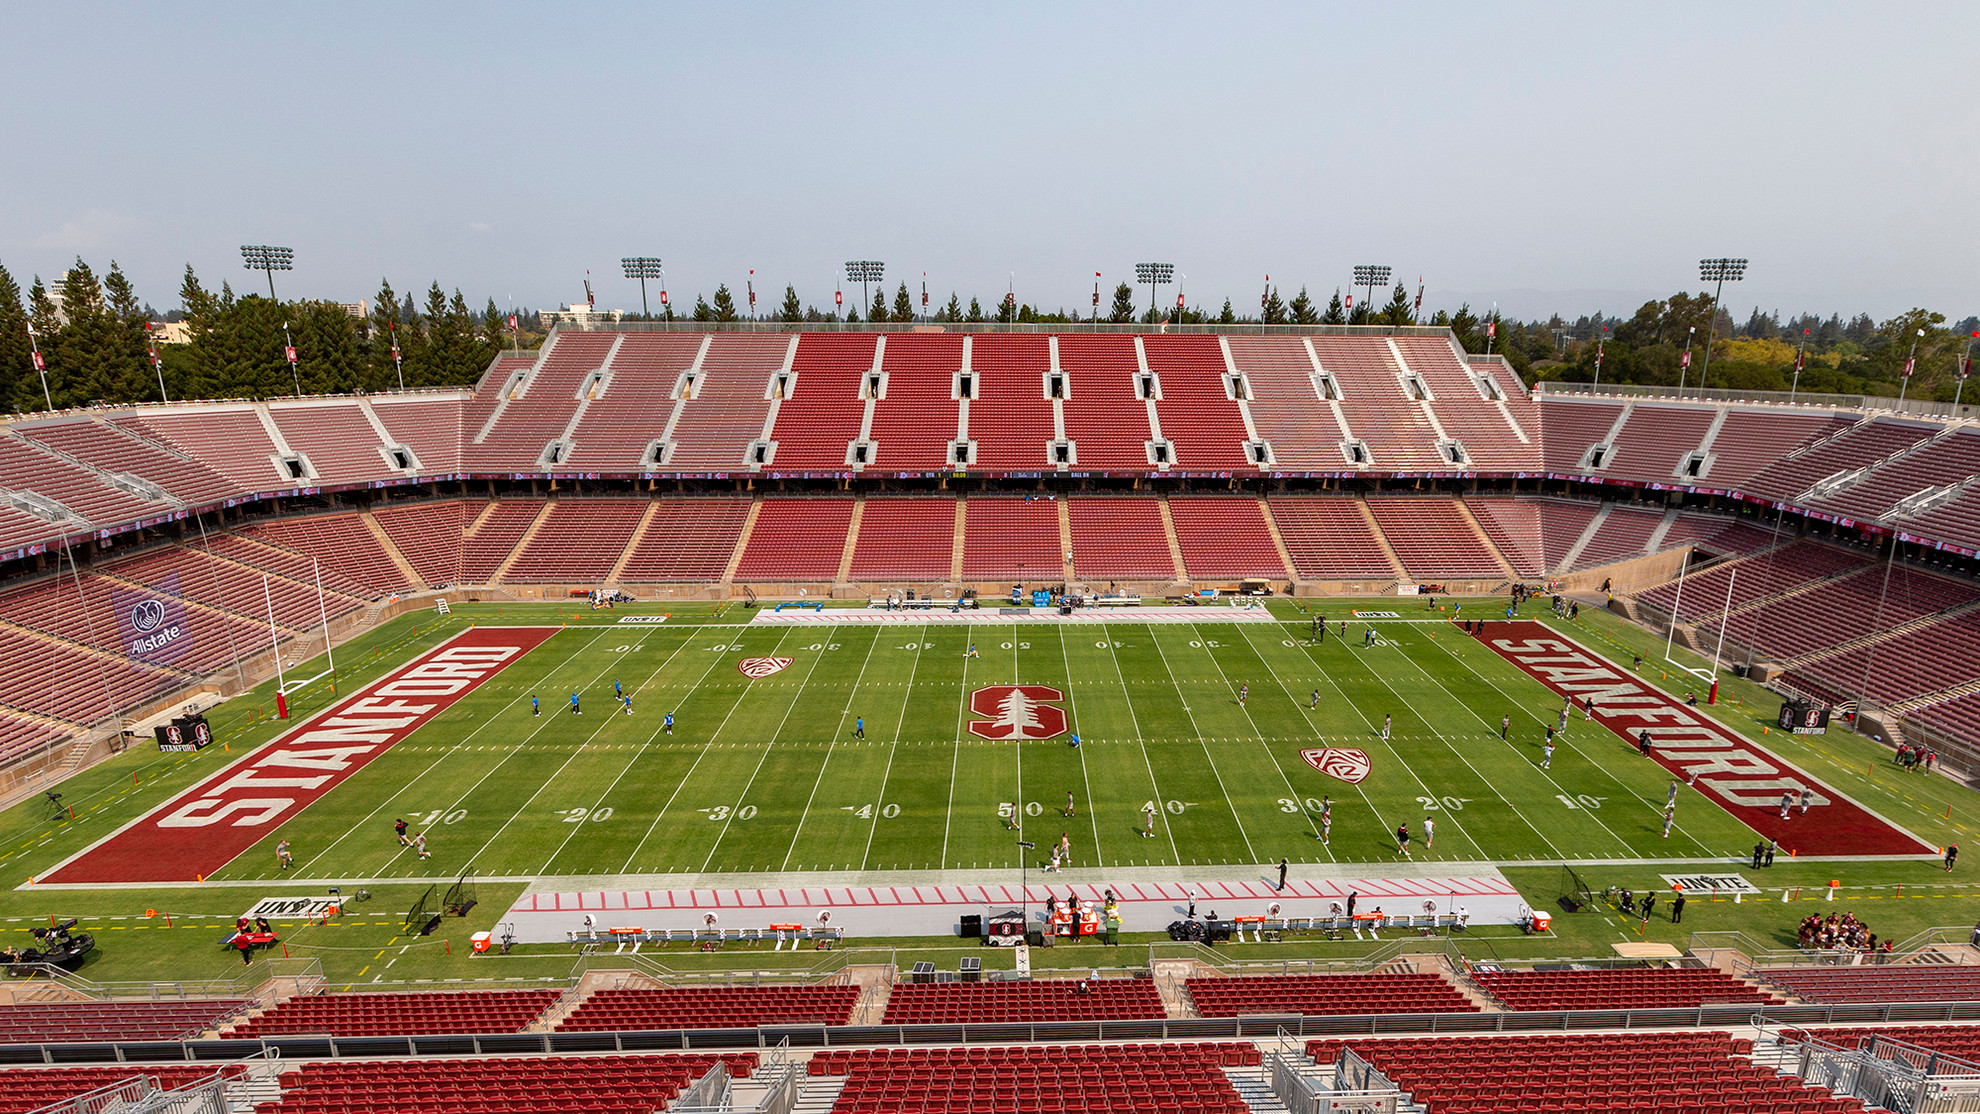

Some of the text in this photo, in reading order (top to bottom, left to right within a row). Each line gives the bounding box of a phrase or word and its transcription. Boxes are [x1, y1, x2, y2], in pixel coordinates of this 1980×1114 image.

[131, 625, 181, 654] Allstate
[1491, 639, 1831, 807] STANFORD
[1792, 727, 1826, 735] STANFORD
[156, 646, 522, 828] STANFORD
[160, 744, 197, 752] STANFORD
[997, 801, 1043, 817] 50
[1140, 800, 1185, 815] 40
[1277, 797, 1325, 813] 30
[1416, 796, 1463, 811] 20
[1555, 794, 1601, 809] 10
[418, 809, 468, 825] 10
[562, 807, 614, 823] 20
[708, 805, 758, 821] 30
[854, 803, 901, 819] 40
[1084, 924, 1093, 933] G
[1540, 920, 1547, 928] G
[474, 941, 482, 949] G
